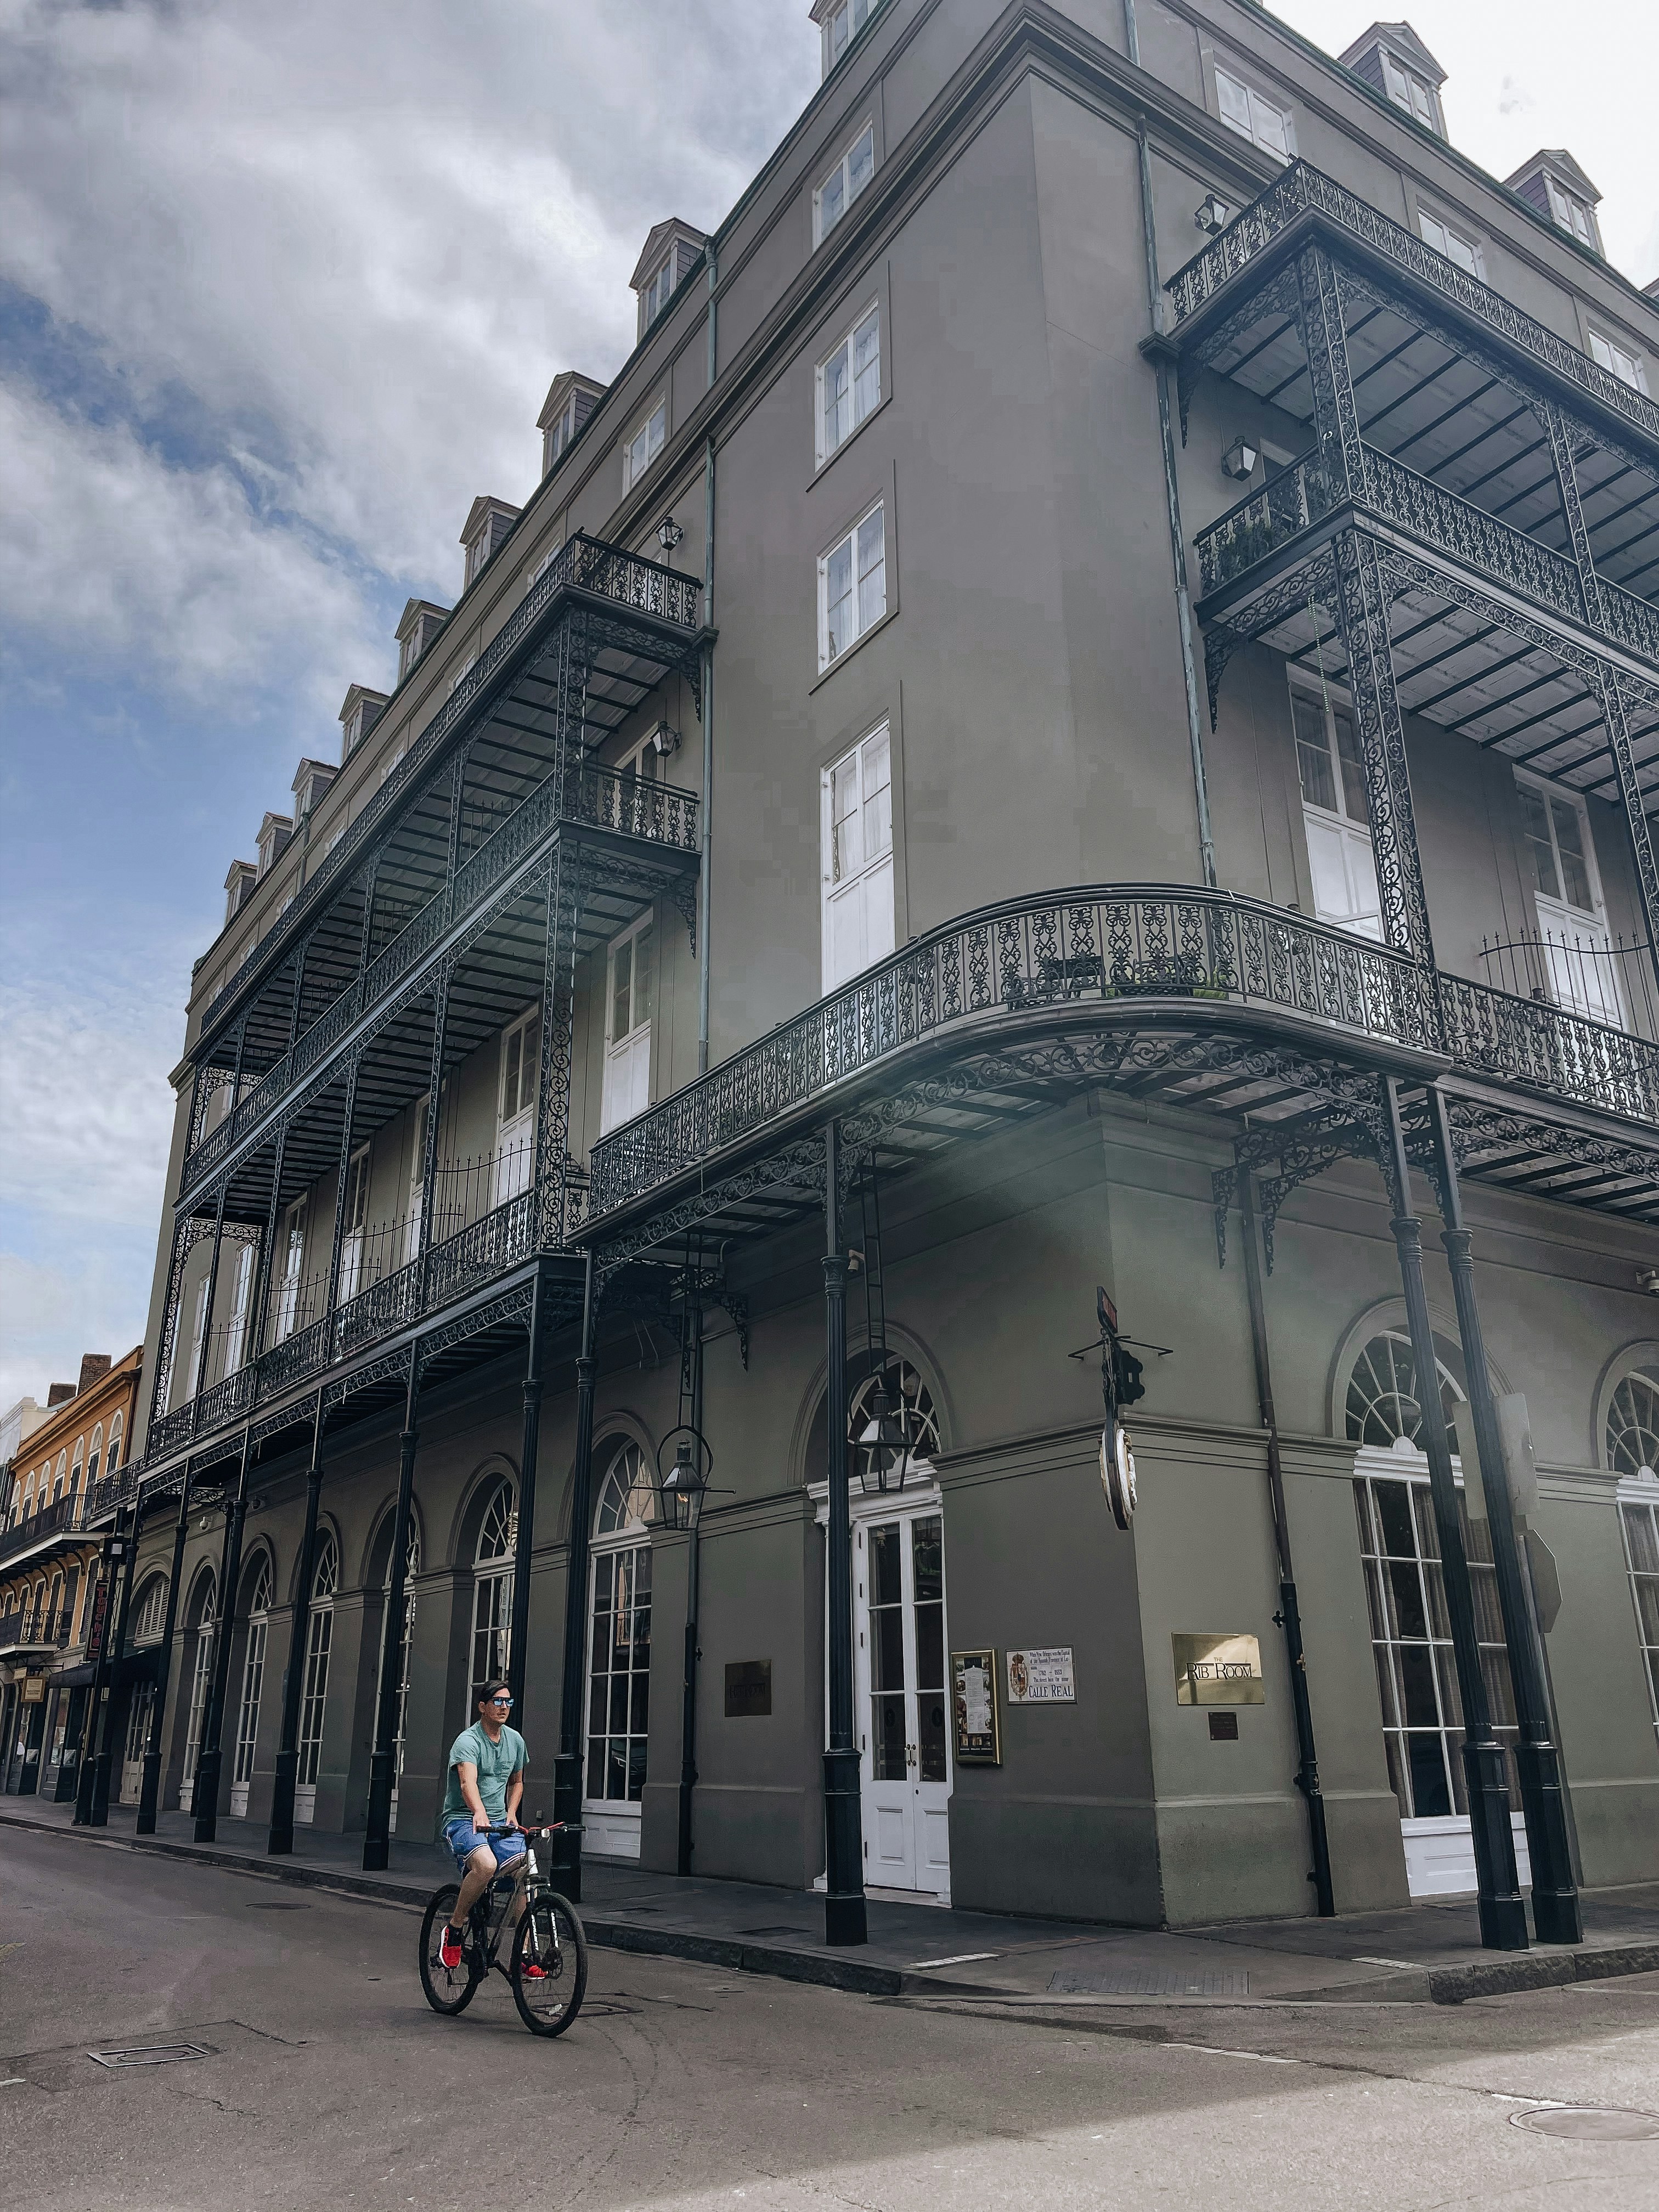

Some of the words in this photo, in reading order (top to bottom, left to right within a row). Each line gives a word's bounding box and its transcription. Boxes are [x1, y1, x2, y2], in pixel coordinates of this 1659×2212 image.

[1186, 1662, 1209, 1680] RIB
[1215, 1662, 1252, 1680] ROOM
[1029, 1685, 1048, 1698] CALLE
[1051, 1684, 1073, 1697] REAL
